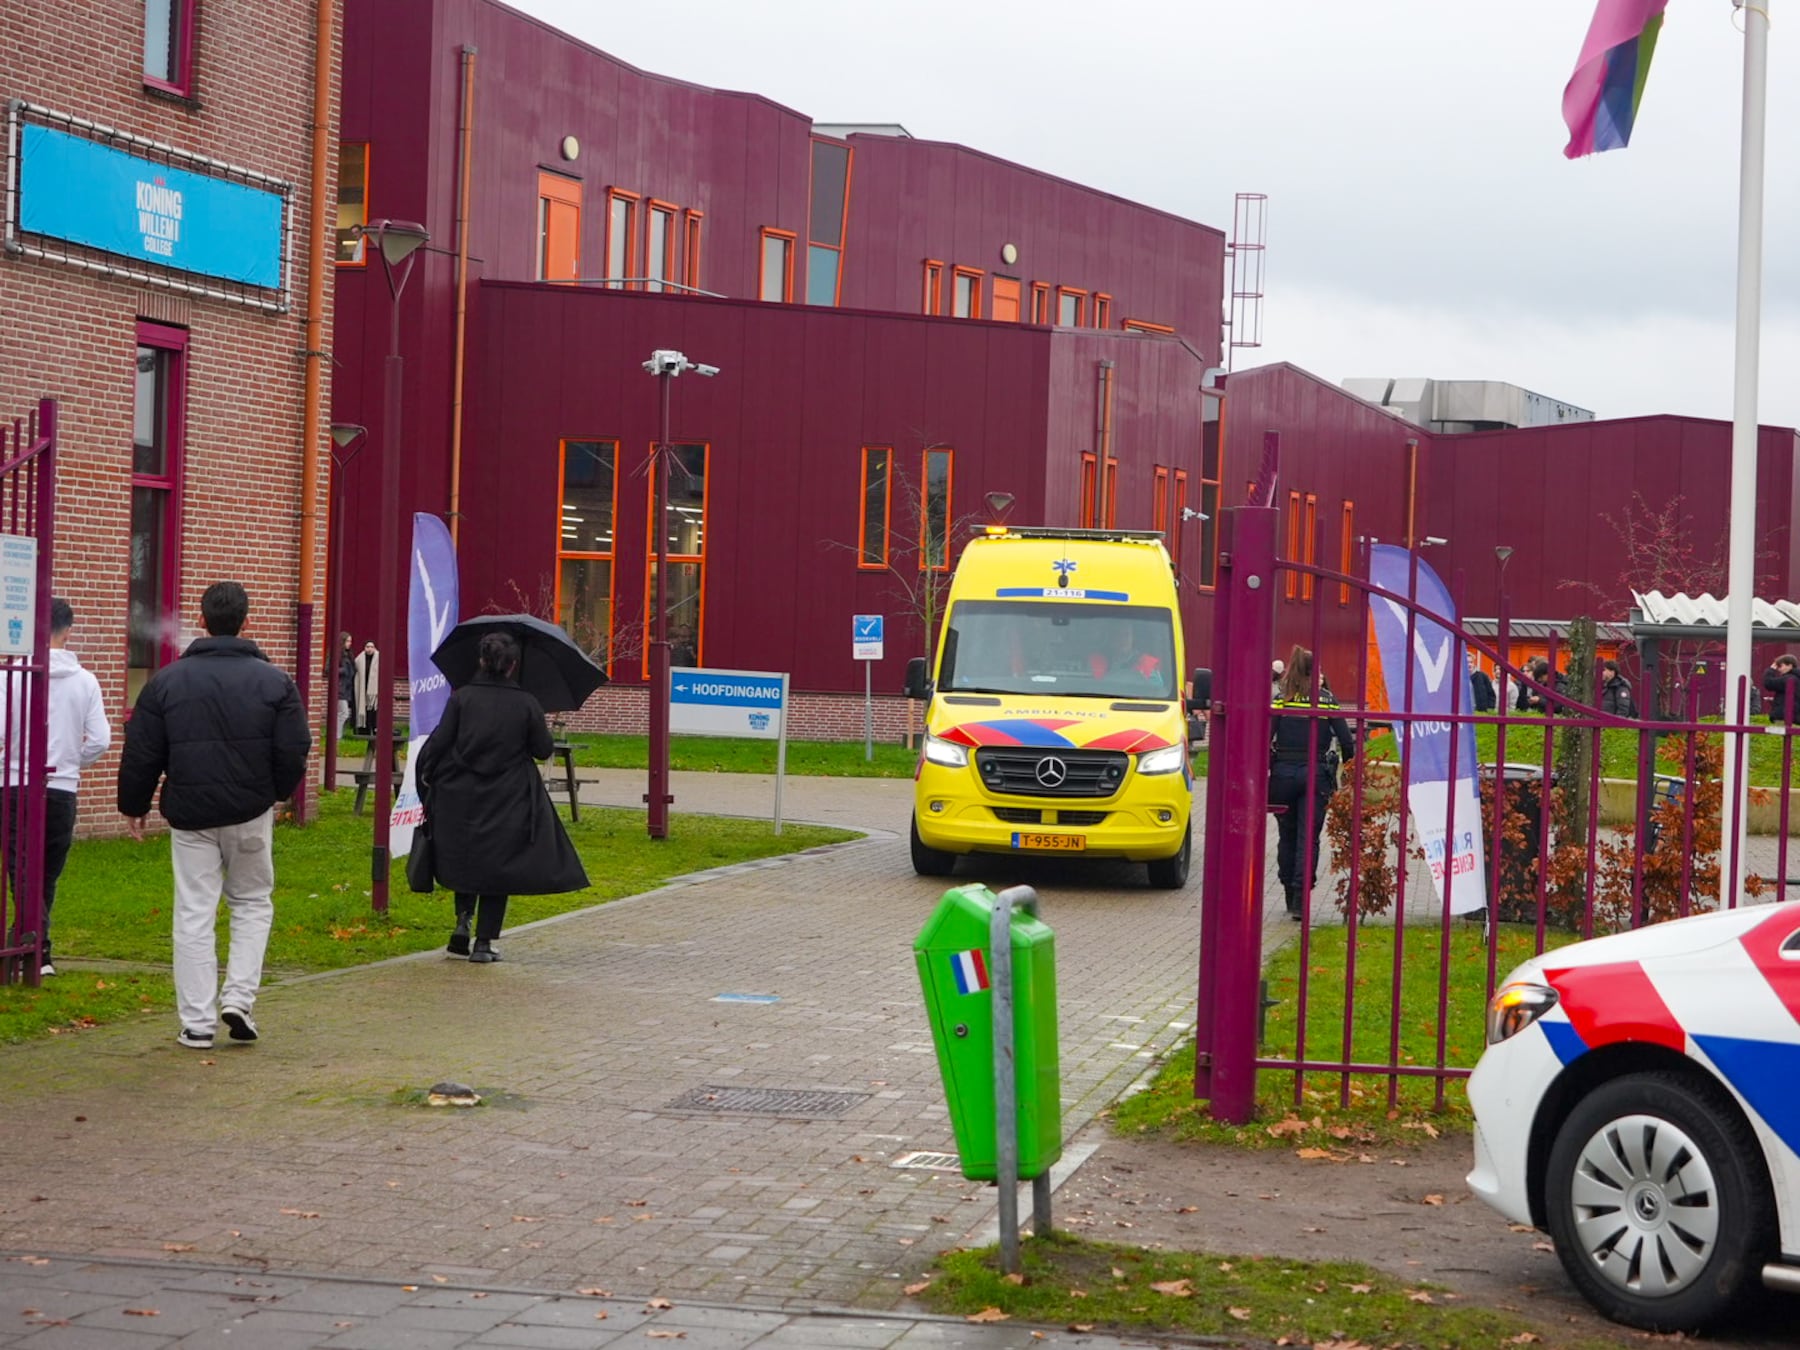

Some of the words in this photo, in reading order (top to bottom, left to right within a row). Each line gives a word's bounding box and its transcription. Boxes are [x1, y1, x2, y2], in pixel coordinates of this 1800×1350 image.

[136, 180, 182, 220] KONING
[139, 210, 174, 241] WILLEM
[144, 235, 173, 256] COLLEGE
[1046, 589, 1083, 598] 21-116
[692, 683, 780, 699] HOOFDINGANG
[1004, 709, 1108, 719] AMBULANCE
[1023, 834, 1081, 848] T-955-JN
